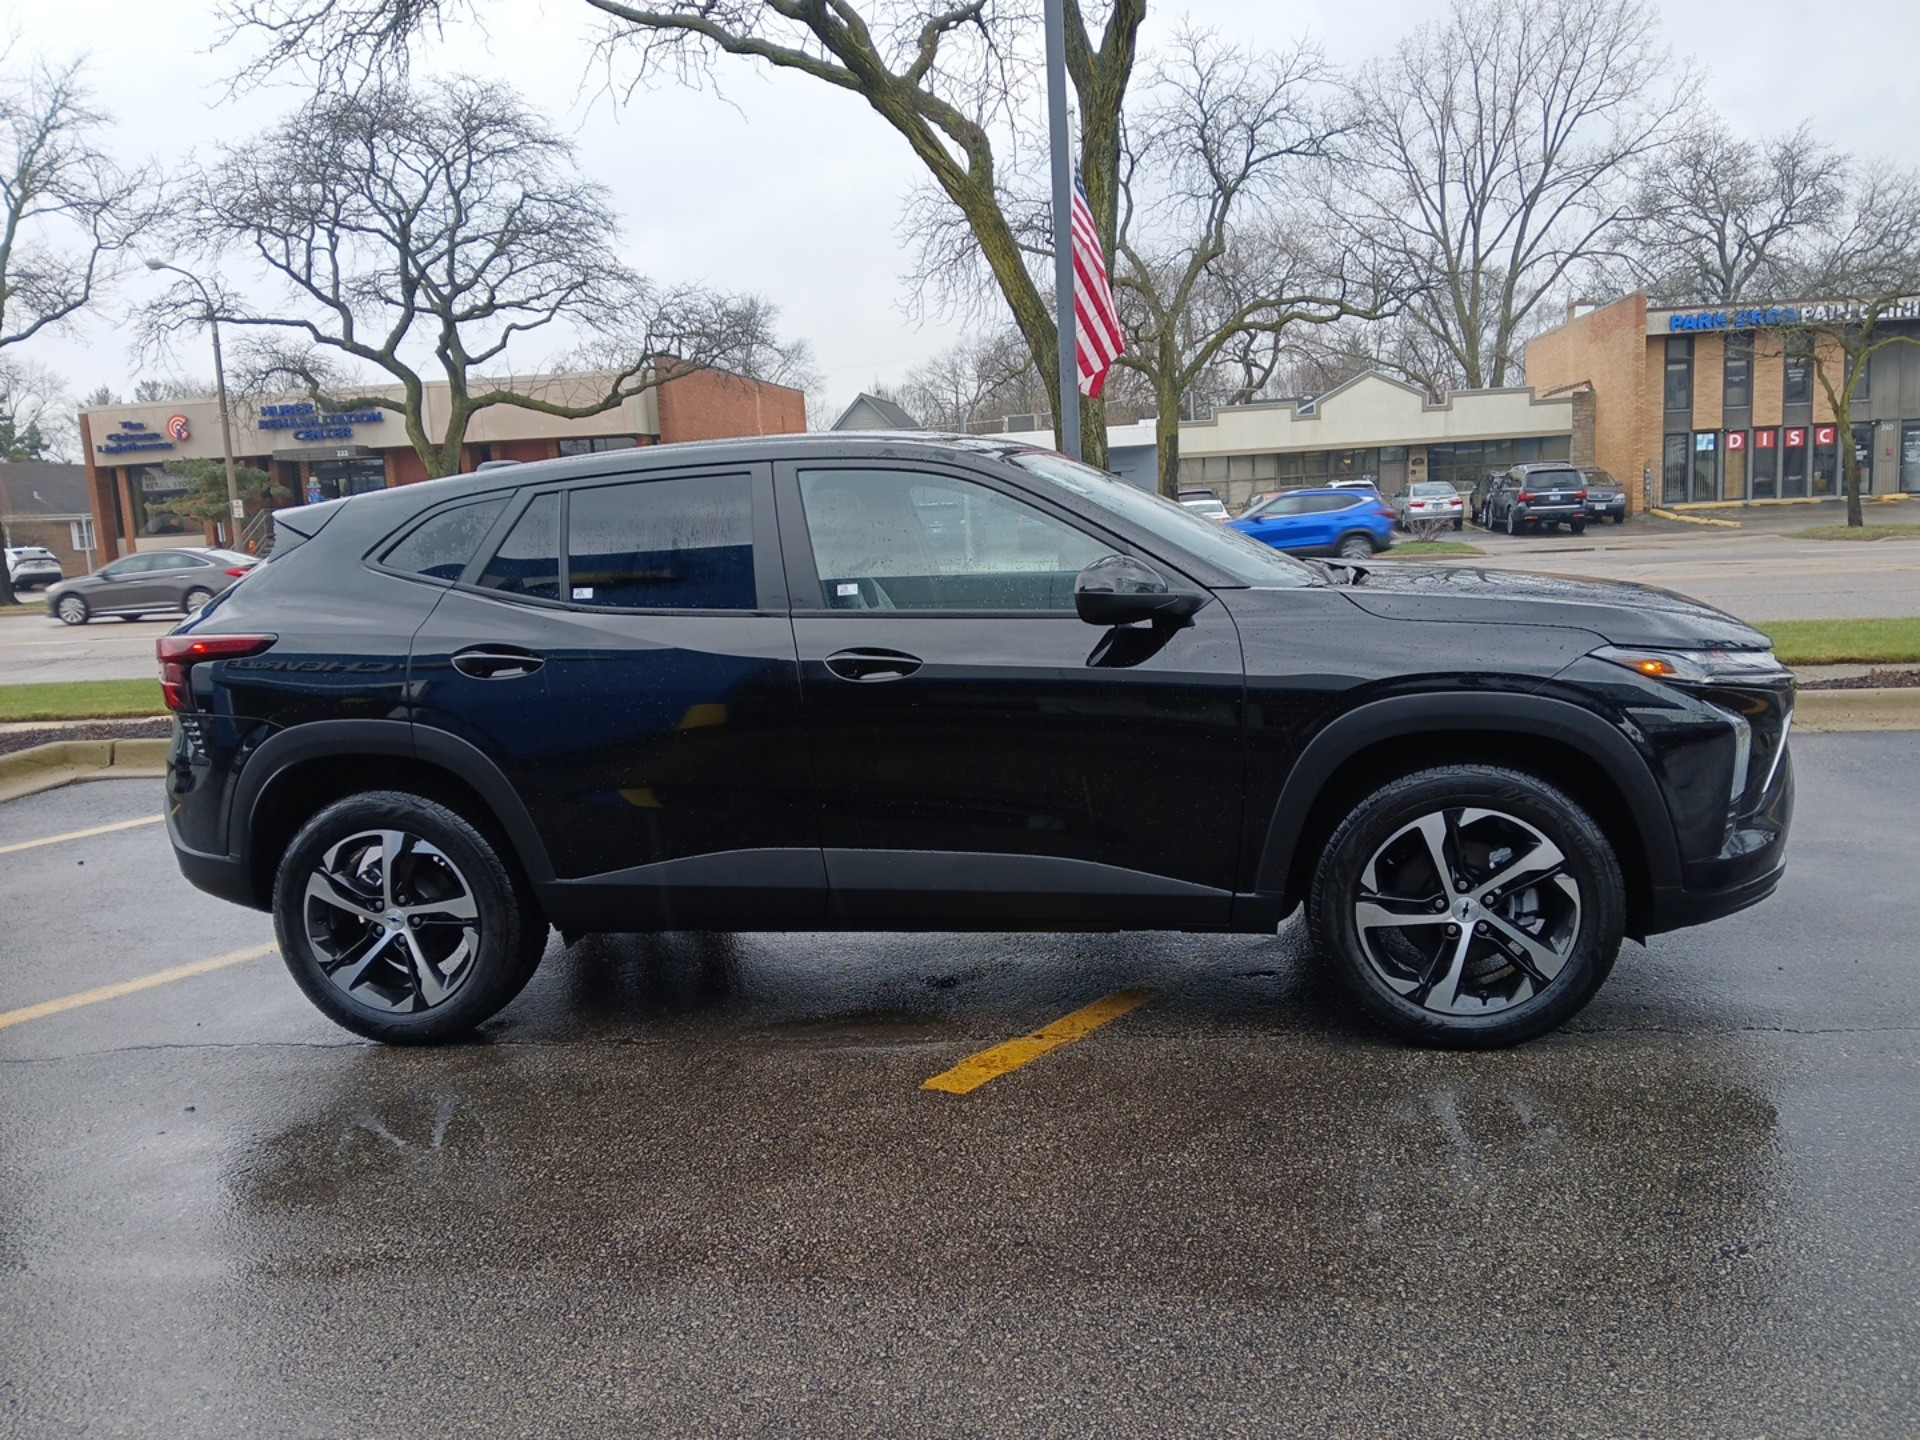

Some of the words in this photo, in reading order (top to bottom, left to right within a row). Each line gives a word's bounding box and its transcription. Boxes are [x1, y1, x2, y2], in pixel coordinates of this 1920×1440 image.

[1669, 312, 1728, 332] PARK
[261, 403, 315, 416] HUBER
[293, 427, 352, 440] CENTER
